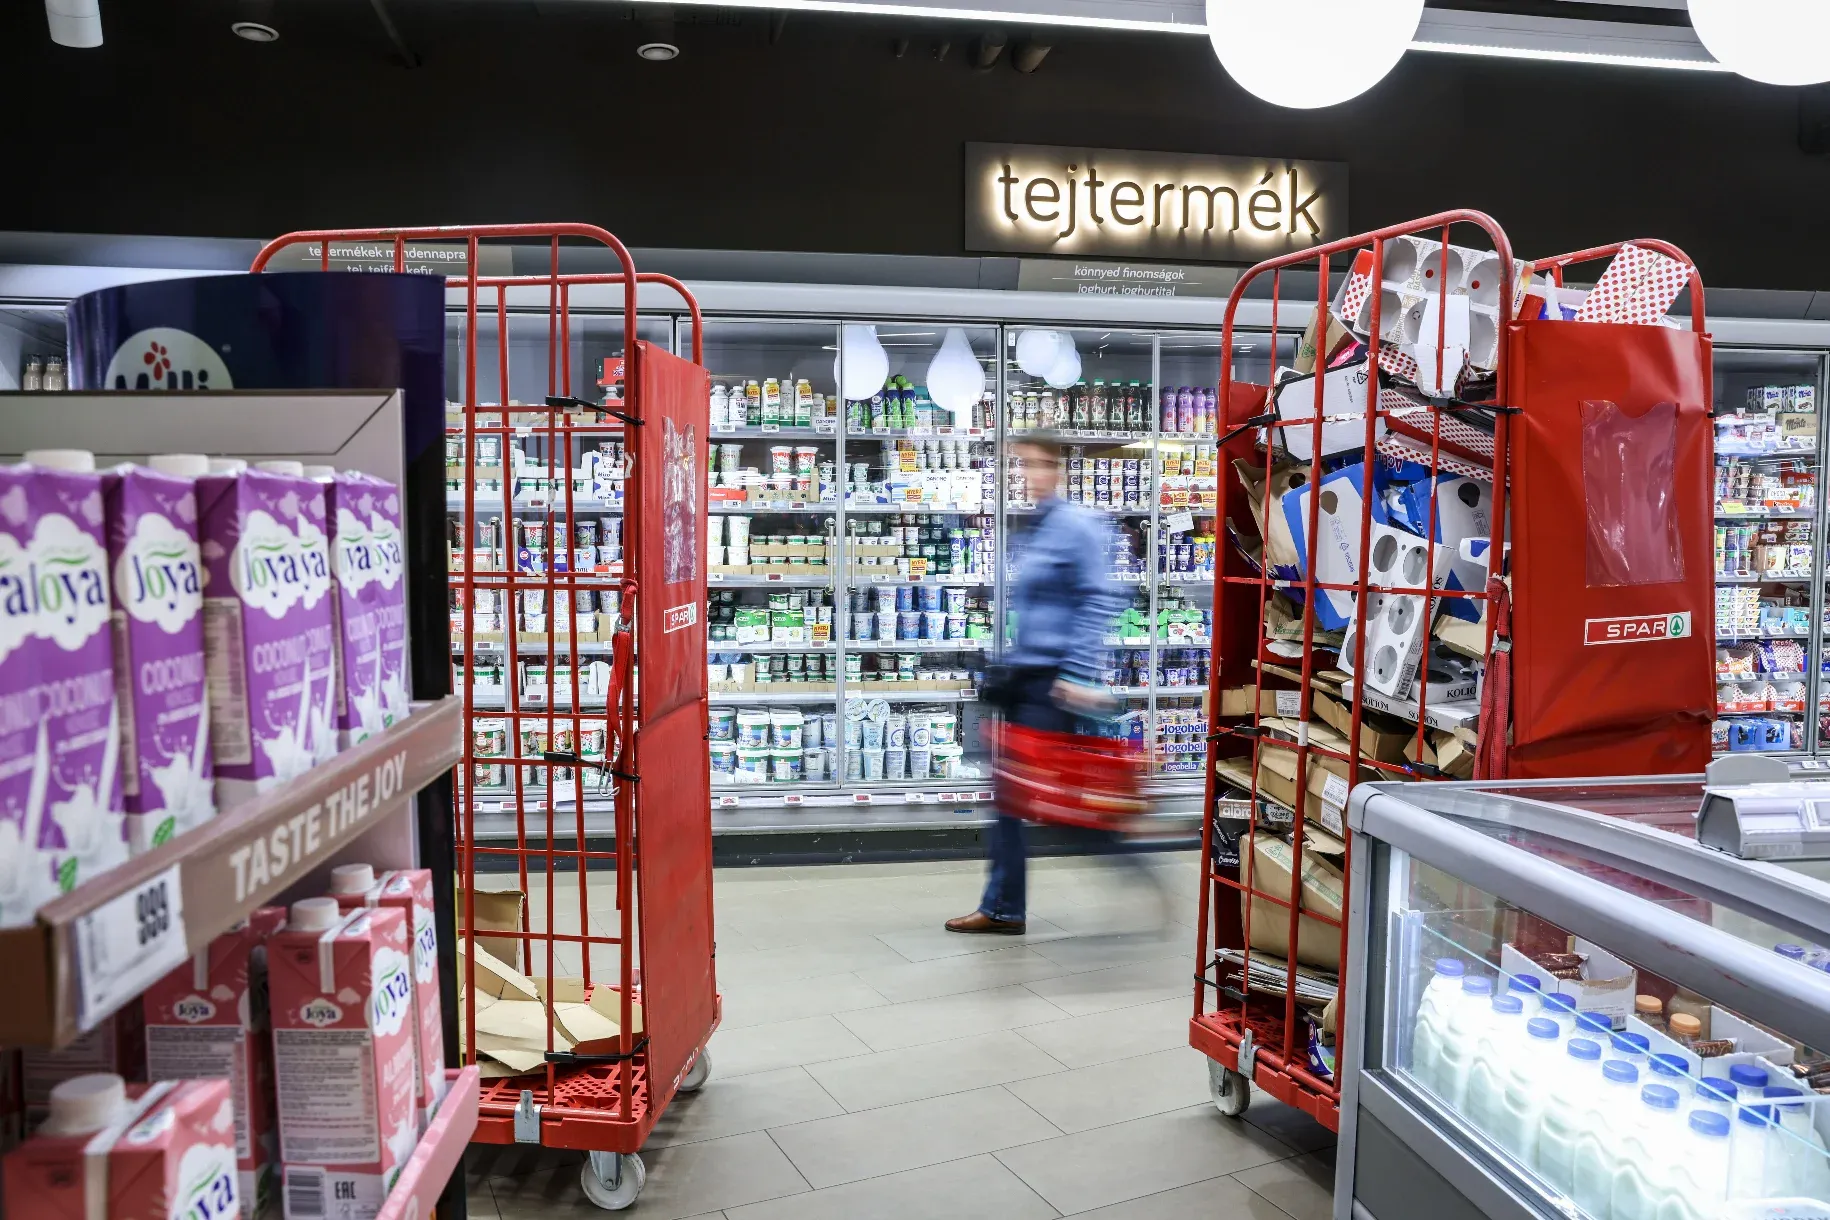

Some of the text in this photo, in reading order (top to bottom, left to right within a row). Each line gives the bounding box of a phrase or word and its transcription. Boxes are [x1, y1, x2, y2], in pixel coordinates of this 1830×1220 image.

[998, 163, 1321, 238] tejtermék
[309, 246, 466, 261] tejermékek mndennapra
[1074, 265, 1185, 281] könnyed finomságok
[133, 554, 200, 611] Joya
[1606, 620, 1666, 638] SPAR
[1164, 723, 1208, 736] Jogobell
[1164, 742, 1207, 755] Jogobell
[229, 750, 407, 903] TASTE THE JOY
[178, 1003, 210, 1020] Joya
[306, 1010, 338, 1023] Joya
[335, 1180, 356, 1200] EAC
